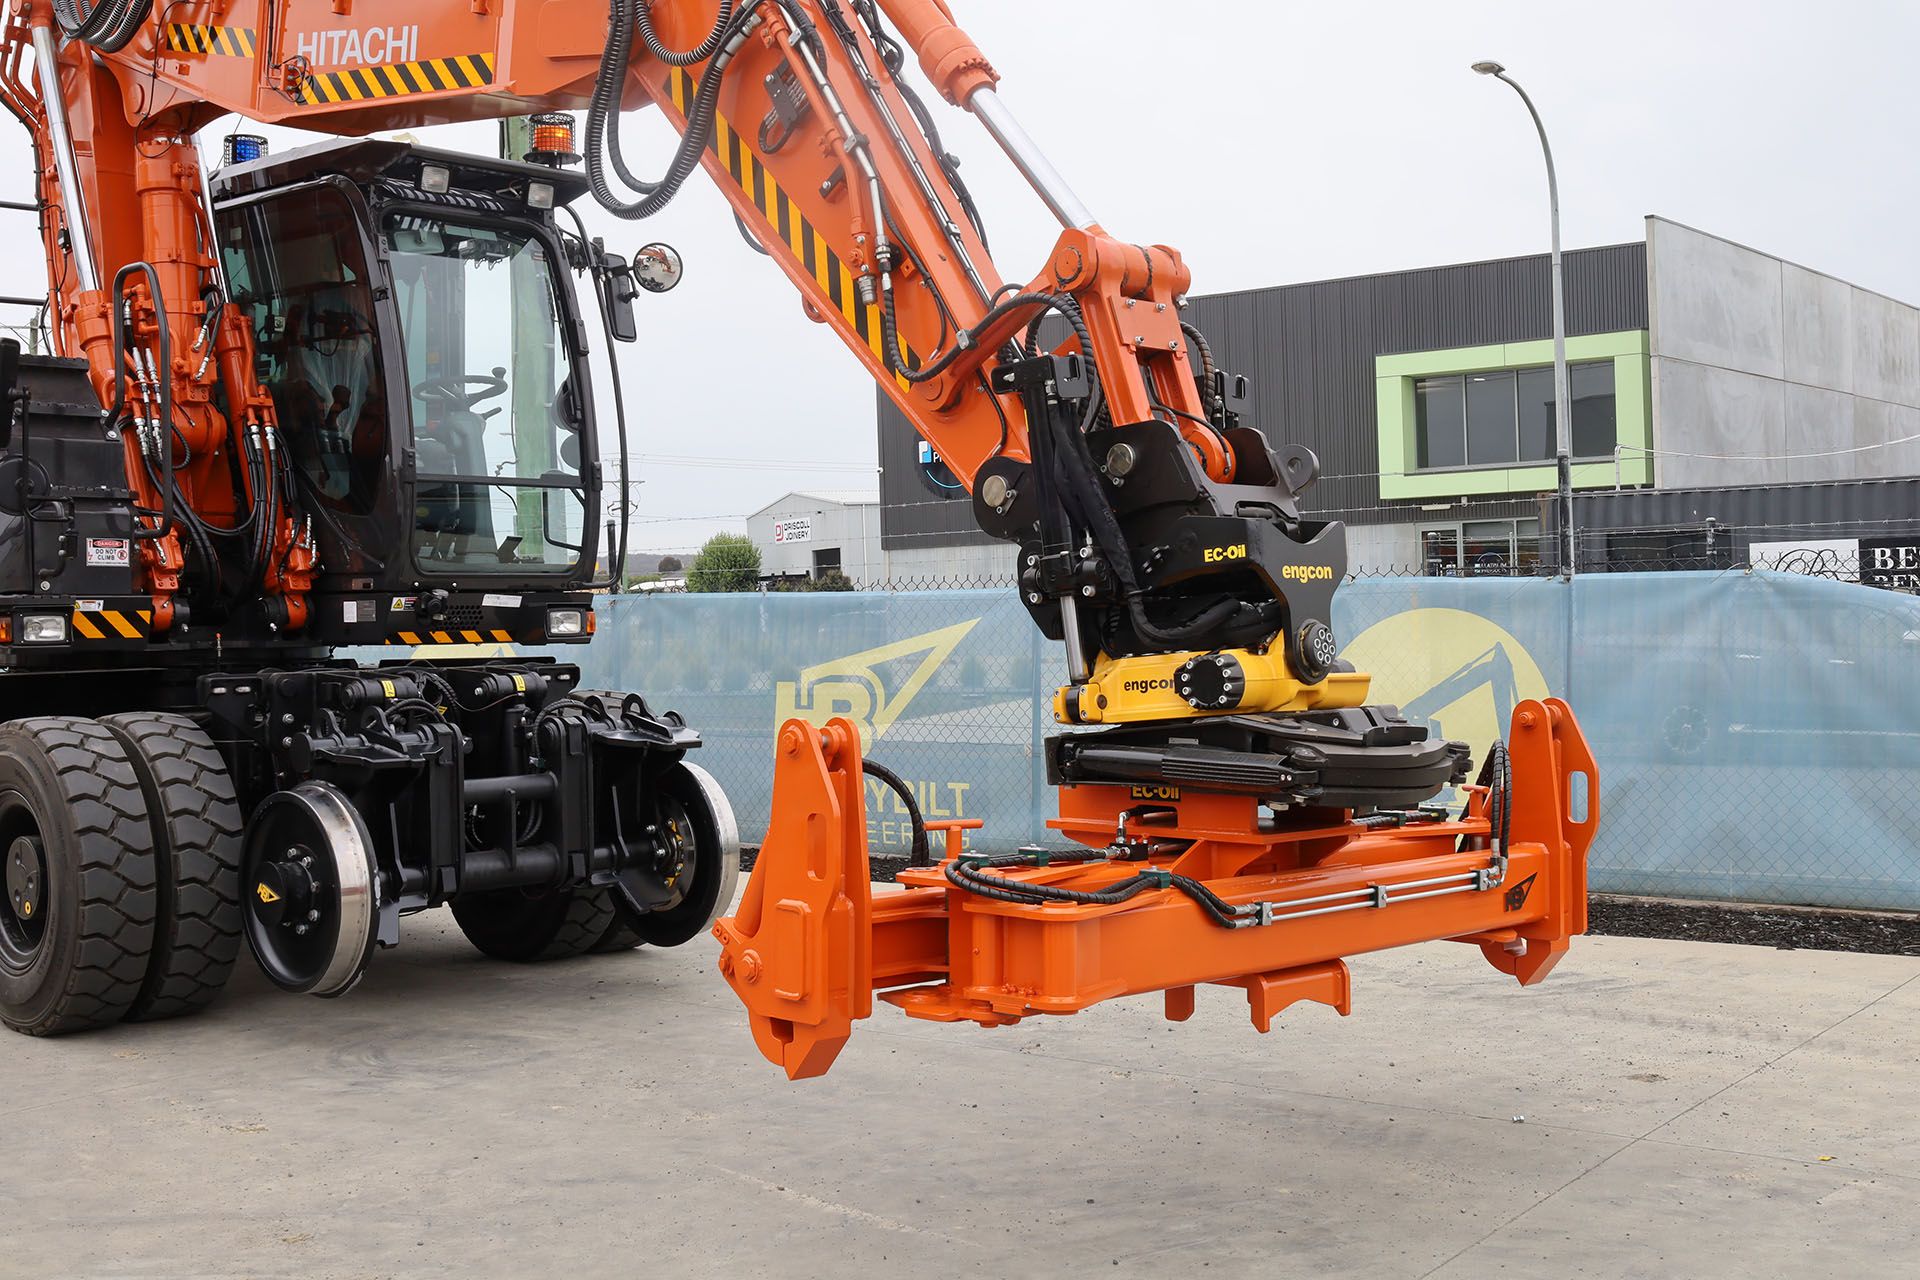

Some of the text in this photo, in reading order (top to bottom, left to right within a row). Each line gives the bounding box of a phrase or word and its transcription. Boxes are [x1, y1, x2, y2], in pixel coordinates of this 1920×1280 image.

[297, 25, 419, 66] HITACHI
[784, 520, 810, 531] DRISCOLL
[785, 530, 809, 541] JOINERY
[1204, 544, 1246, 563] EC-Oil
[1872, 546, 1920, 570] BE
[1282, 564, 1333, 584] engcon
